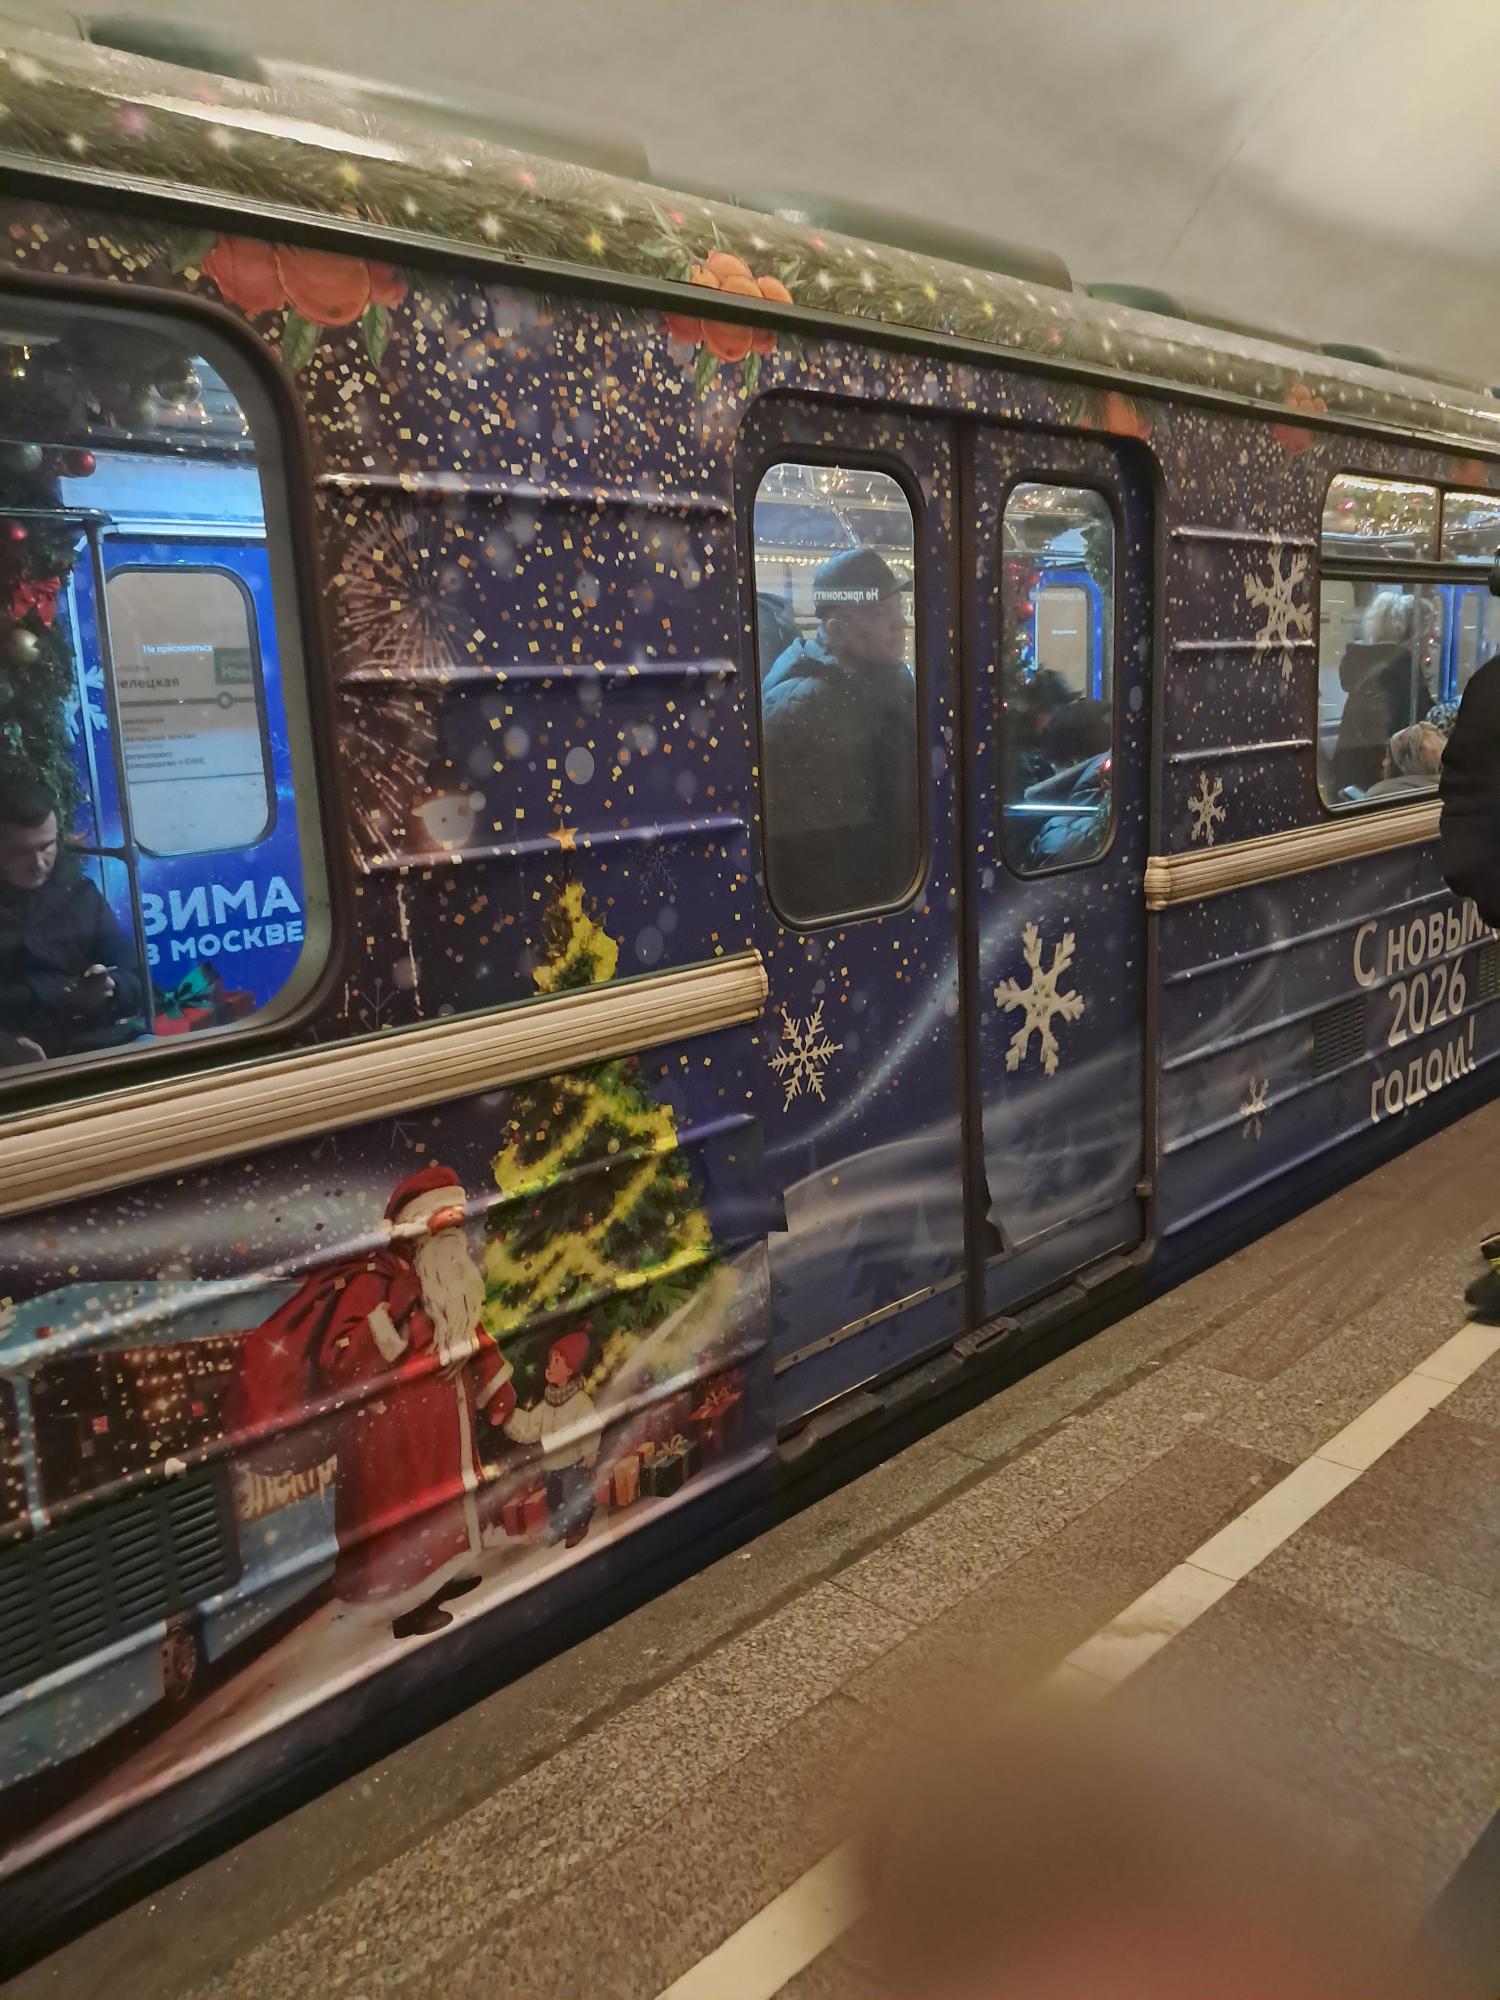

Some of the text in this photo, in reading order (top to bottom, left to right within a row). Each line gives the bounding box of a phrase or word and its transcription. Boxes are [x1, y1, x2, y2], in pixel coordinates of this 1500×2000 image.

[117, 677, 181, 691] елецкая
[142, 876, 301, 937] ЗИМА
[170, 920, 305, 962] МОСКВЕ
[1352, 920, 1379, 988] С
[1387, 956, 1468, 1048] 2026
[1370, 1014, 1478, 1125] годом!
